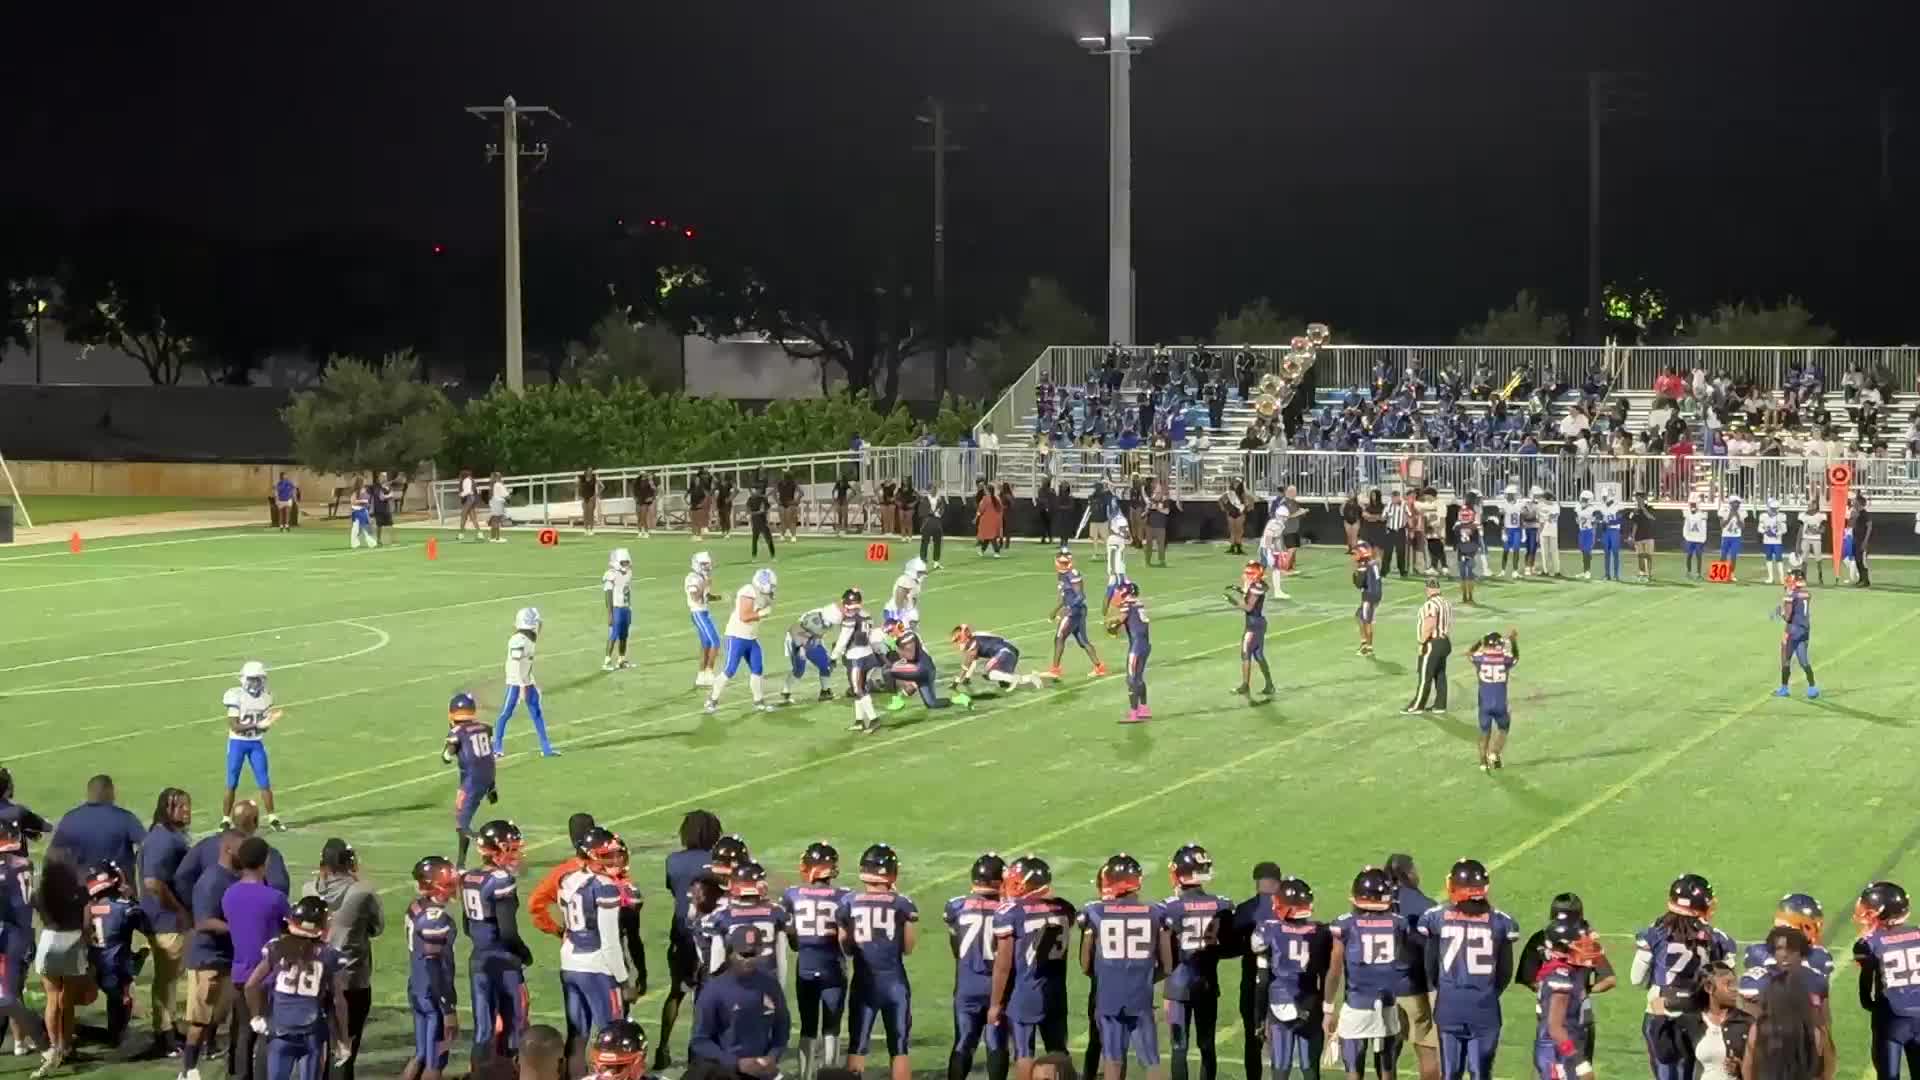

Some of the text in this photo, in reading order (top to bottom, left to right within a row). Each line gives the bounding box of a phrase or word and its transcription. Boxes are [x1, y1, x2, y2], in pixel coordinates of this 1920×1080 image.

[540, 531, 553, 545] G
[868, 543, 885, 560] 10
[1710, 563, 1730, 581] 30
[1480, 663, 1506, 683] 26
[470, 732, 491, 757] 18
[462, 887, 484, 920] 19
[793, 900, 838, 936] 22
[1023, 915, 1068, 965] 73
[1100, 918, 1152, 959] 82
[1361, 934, 1395, 964] 13
[1440, 926, 1494, 975] 72
[1289, 940, 1310, 972] 4
